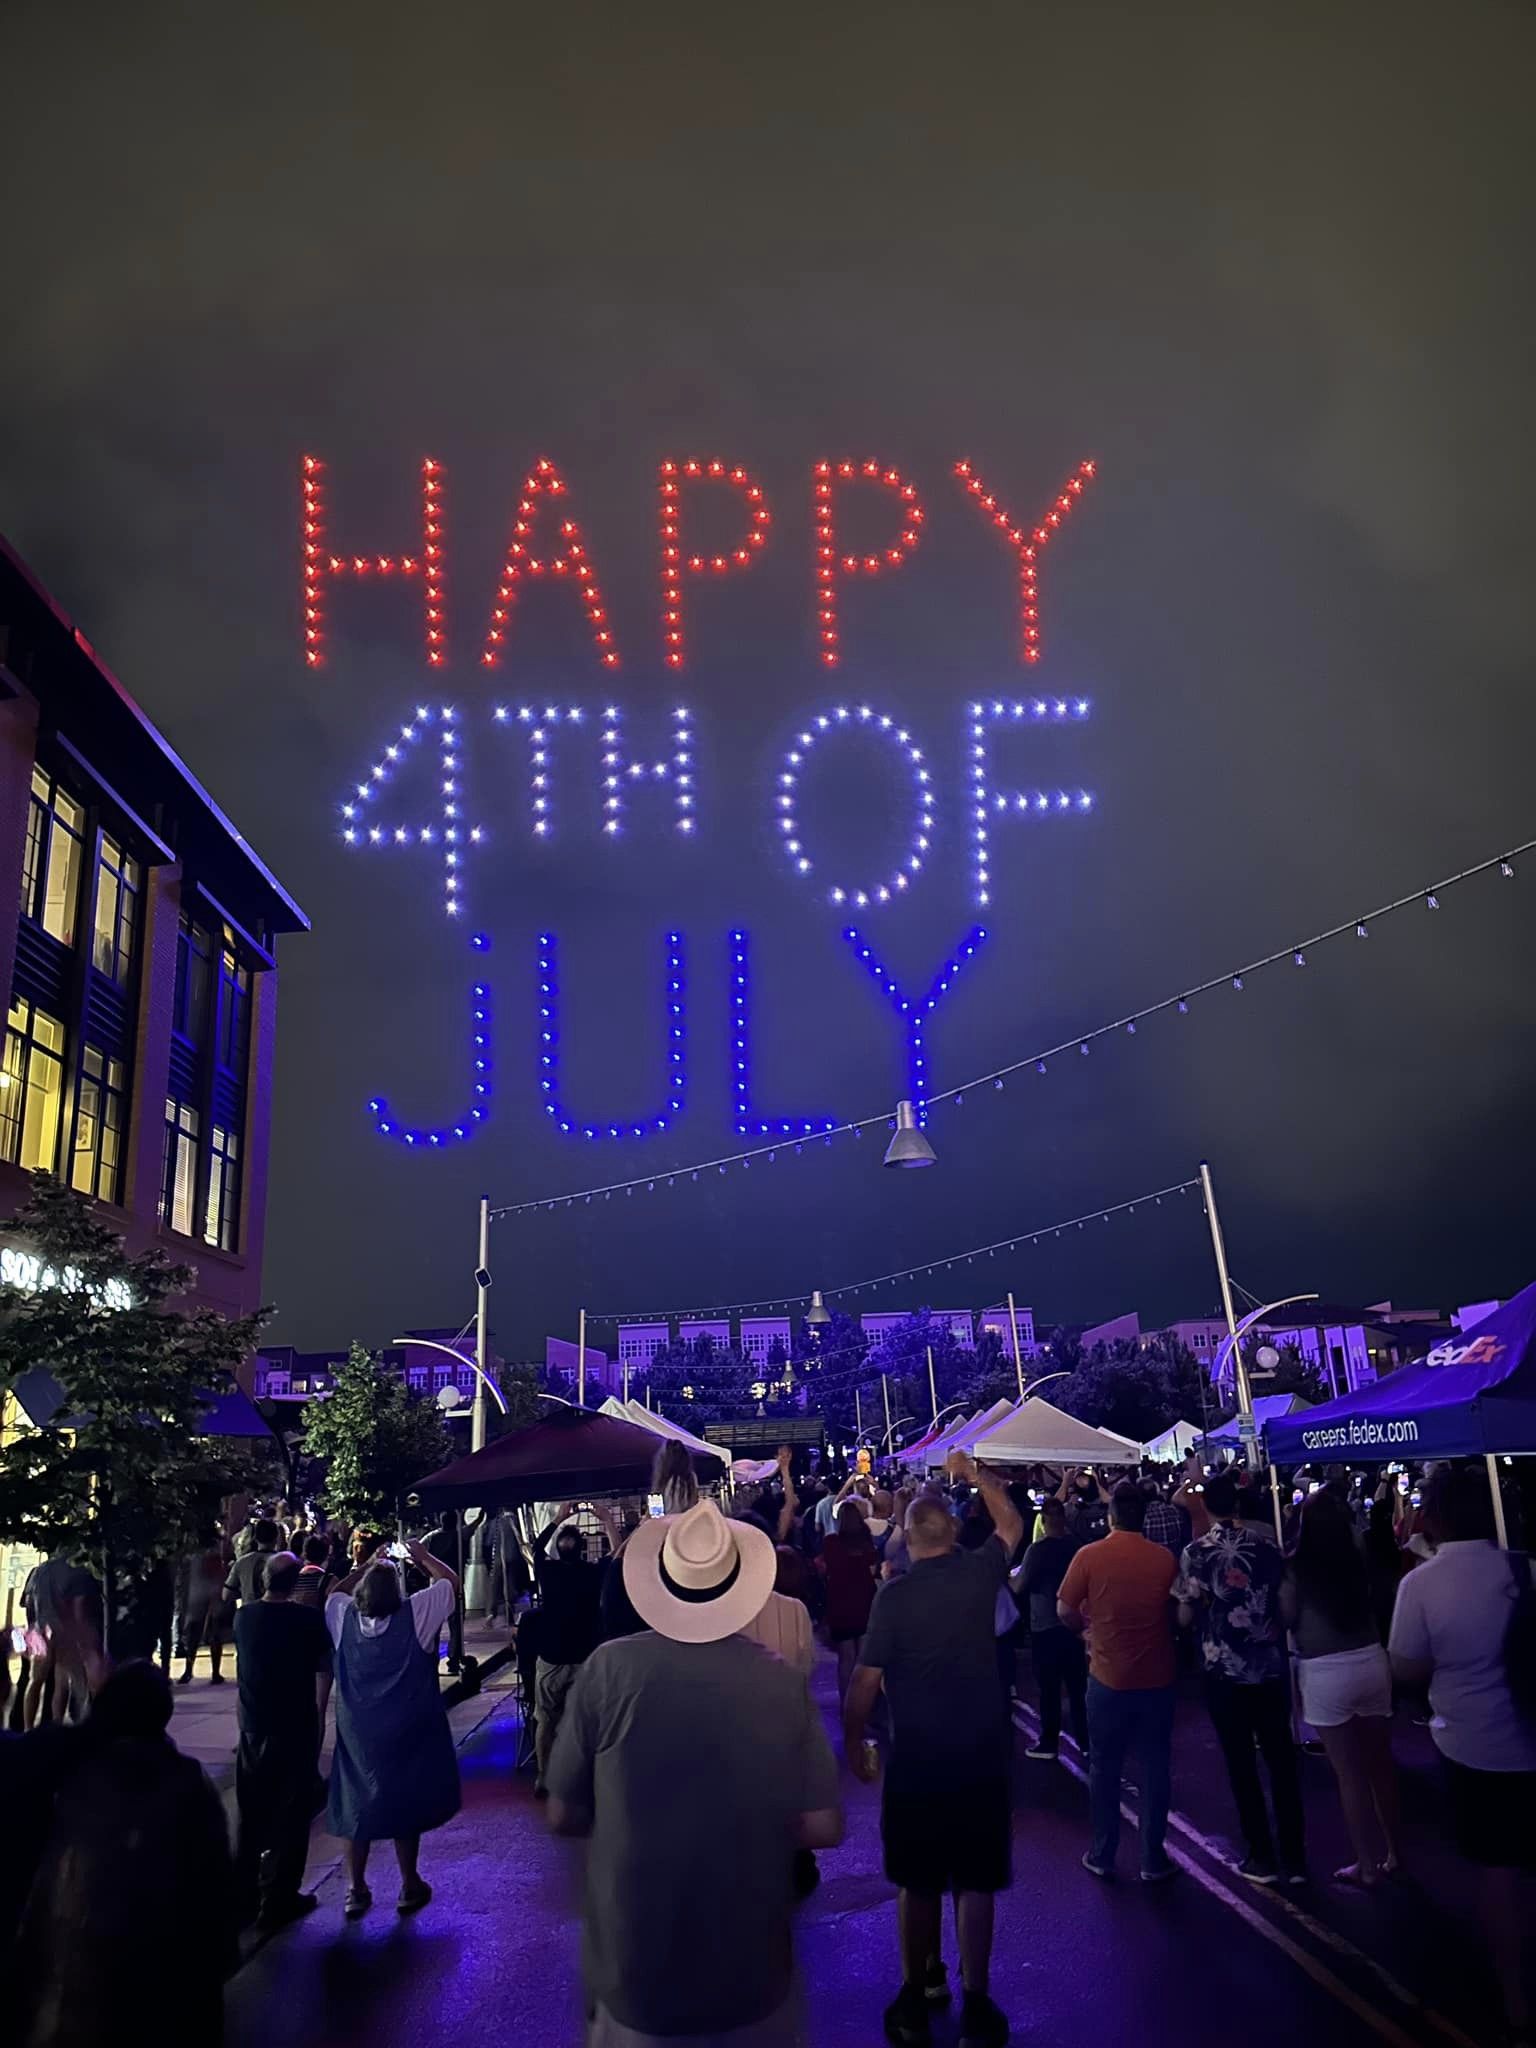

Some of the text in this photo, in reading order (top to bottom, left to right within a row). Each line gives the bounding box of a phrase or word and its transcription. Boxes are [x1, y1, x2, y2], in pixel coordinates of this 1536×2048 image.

[301, 455, 1097, 666] HAPPY
[338, 698, 1094, 917] 4TH OF
[1412, 1335, 1507, 1367] edEx
[1302, 1418, 1418, 1449] careers.fedex.com
